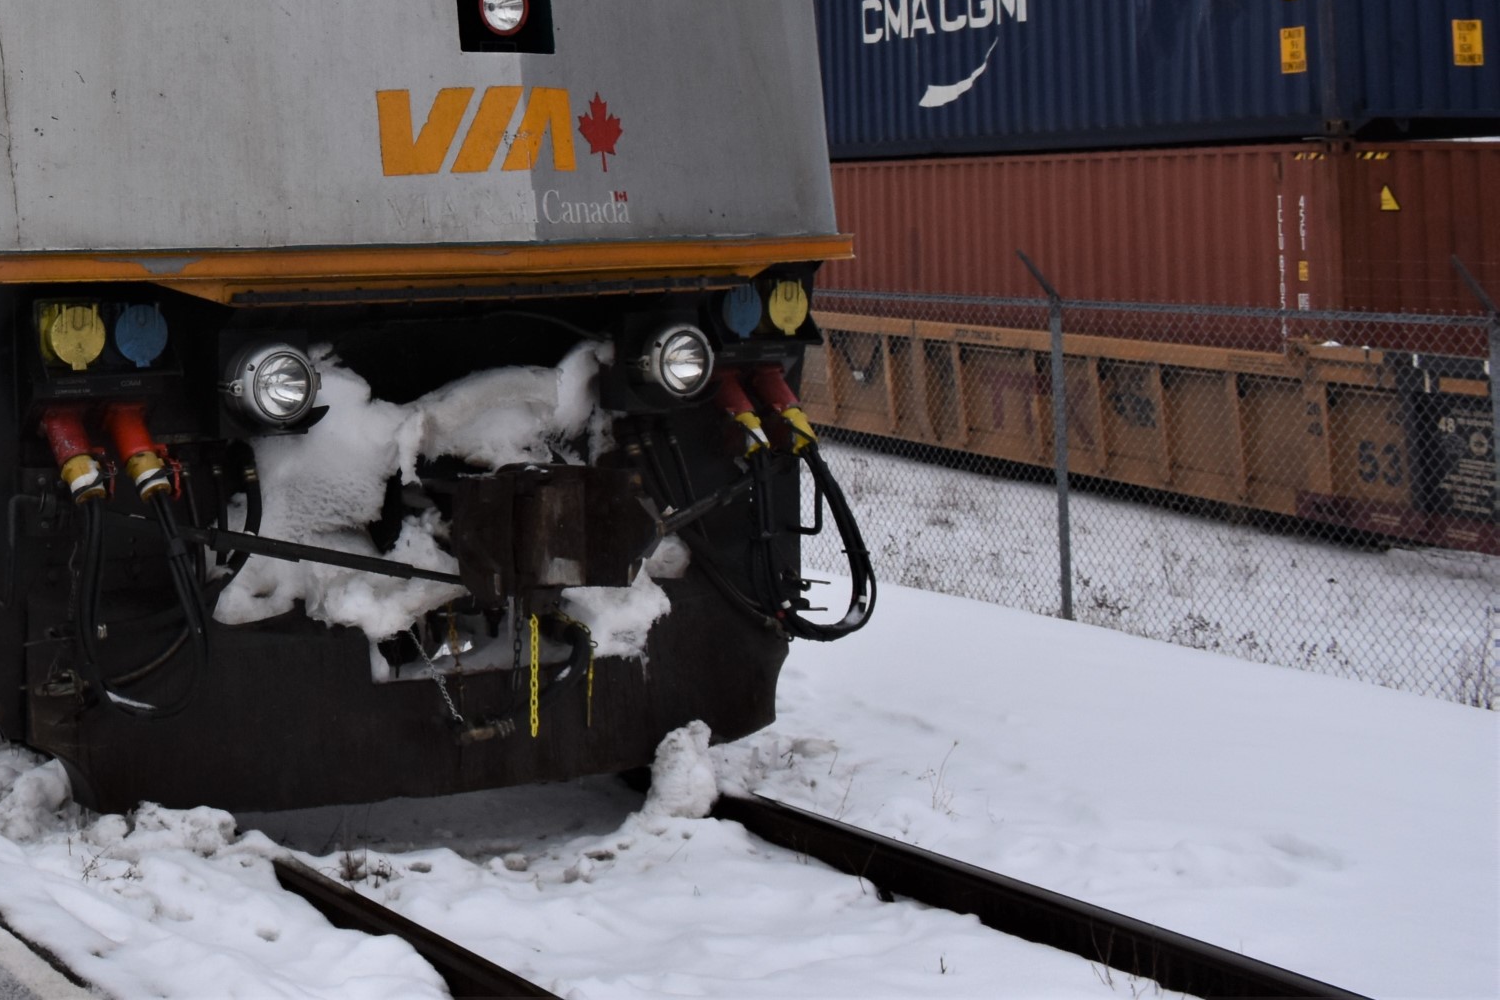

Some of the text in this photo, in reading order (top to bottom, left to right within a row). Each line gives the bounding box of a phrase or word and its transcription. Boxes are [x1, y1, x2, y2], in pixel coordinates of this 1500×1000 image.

[376, 85, 577, 177] VIA
[542, 189, 631, 225] Canada
[1358, 440, 1403, 487] 53
